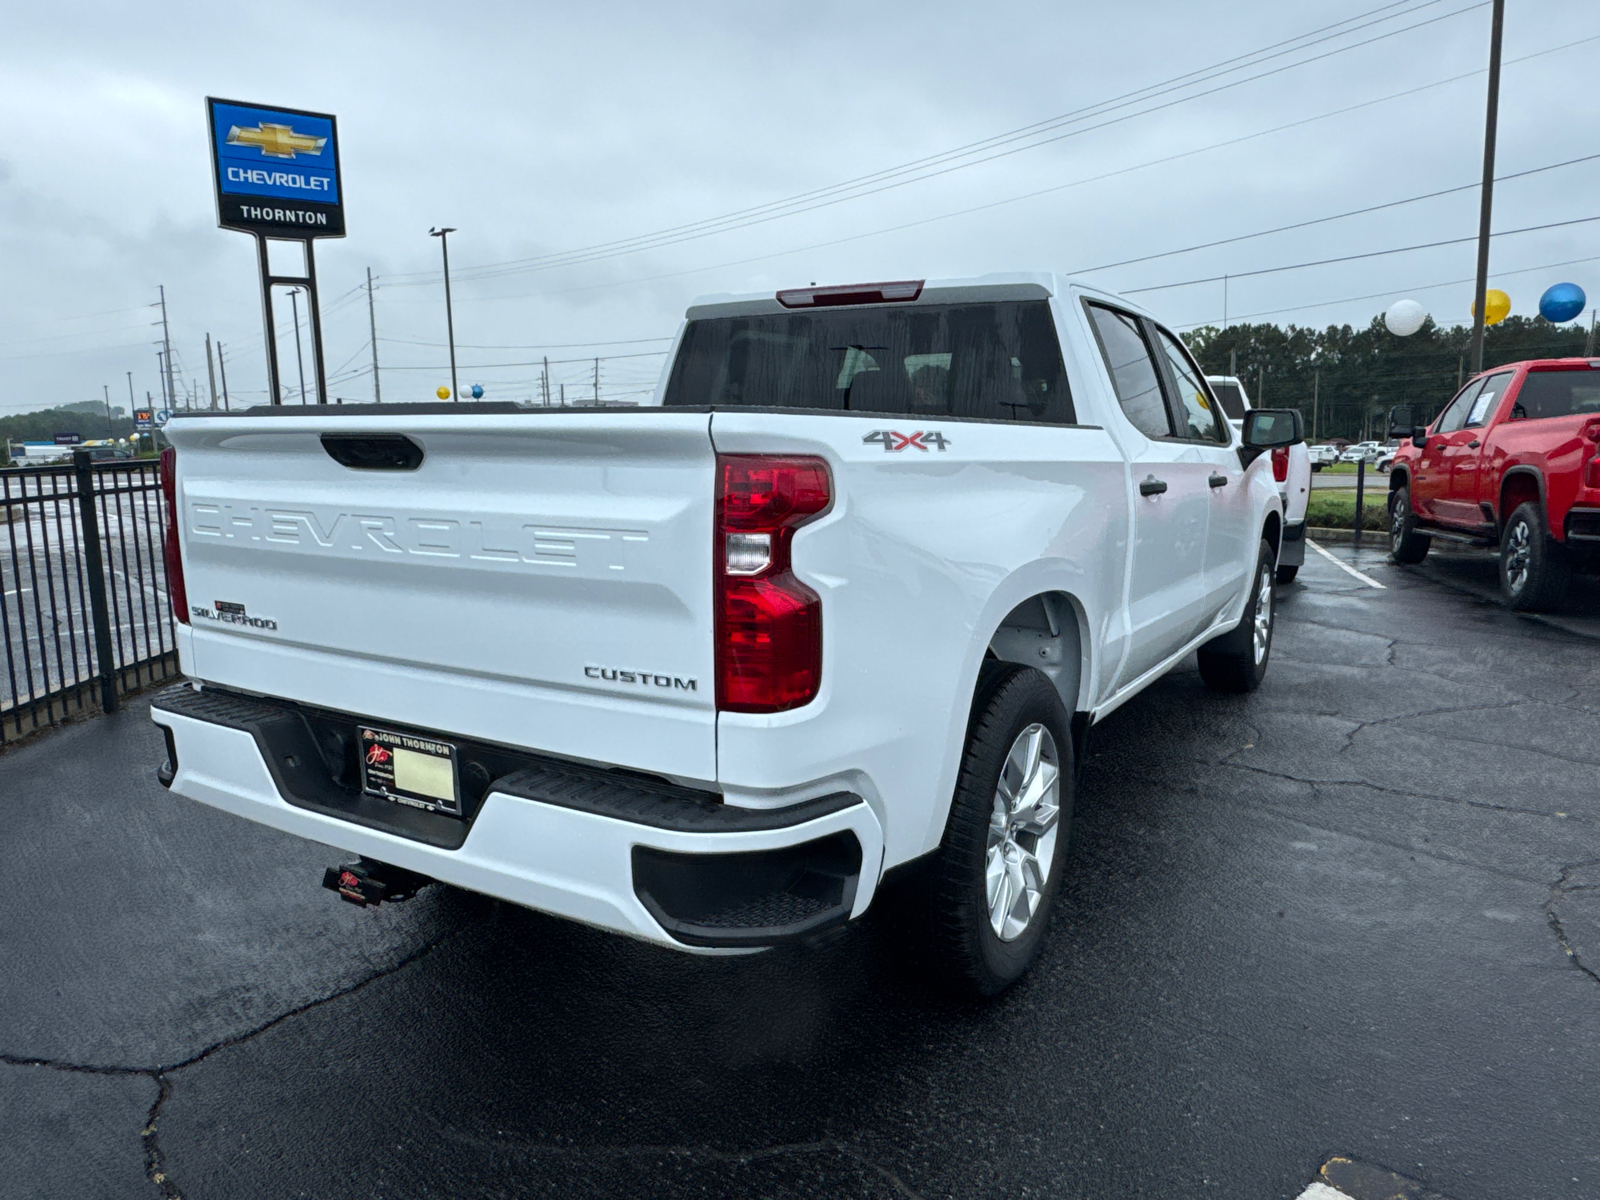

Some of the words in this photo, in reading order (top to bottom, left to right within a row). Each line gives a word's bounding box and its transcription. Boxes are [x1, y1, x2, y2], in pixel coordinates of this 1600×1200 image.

[227, 167, 331, 191] CHEVROLET
[240, 205, 327, 225] THORNTON
[191, 502, 649, 571] CHEVROLET
[191, 606, 277, 630] SILVERADO
[584, 665, 698, 691] CUSTOM
[378, 733, 402, 745] JOHN
[402, 737, 450, 756] THORNTON
